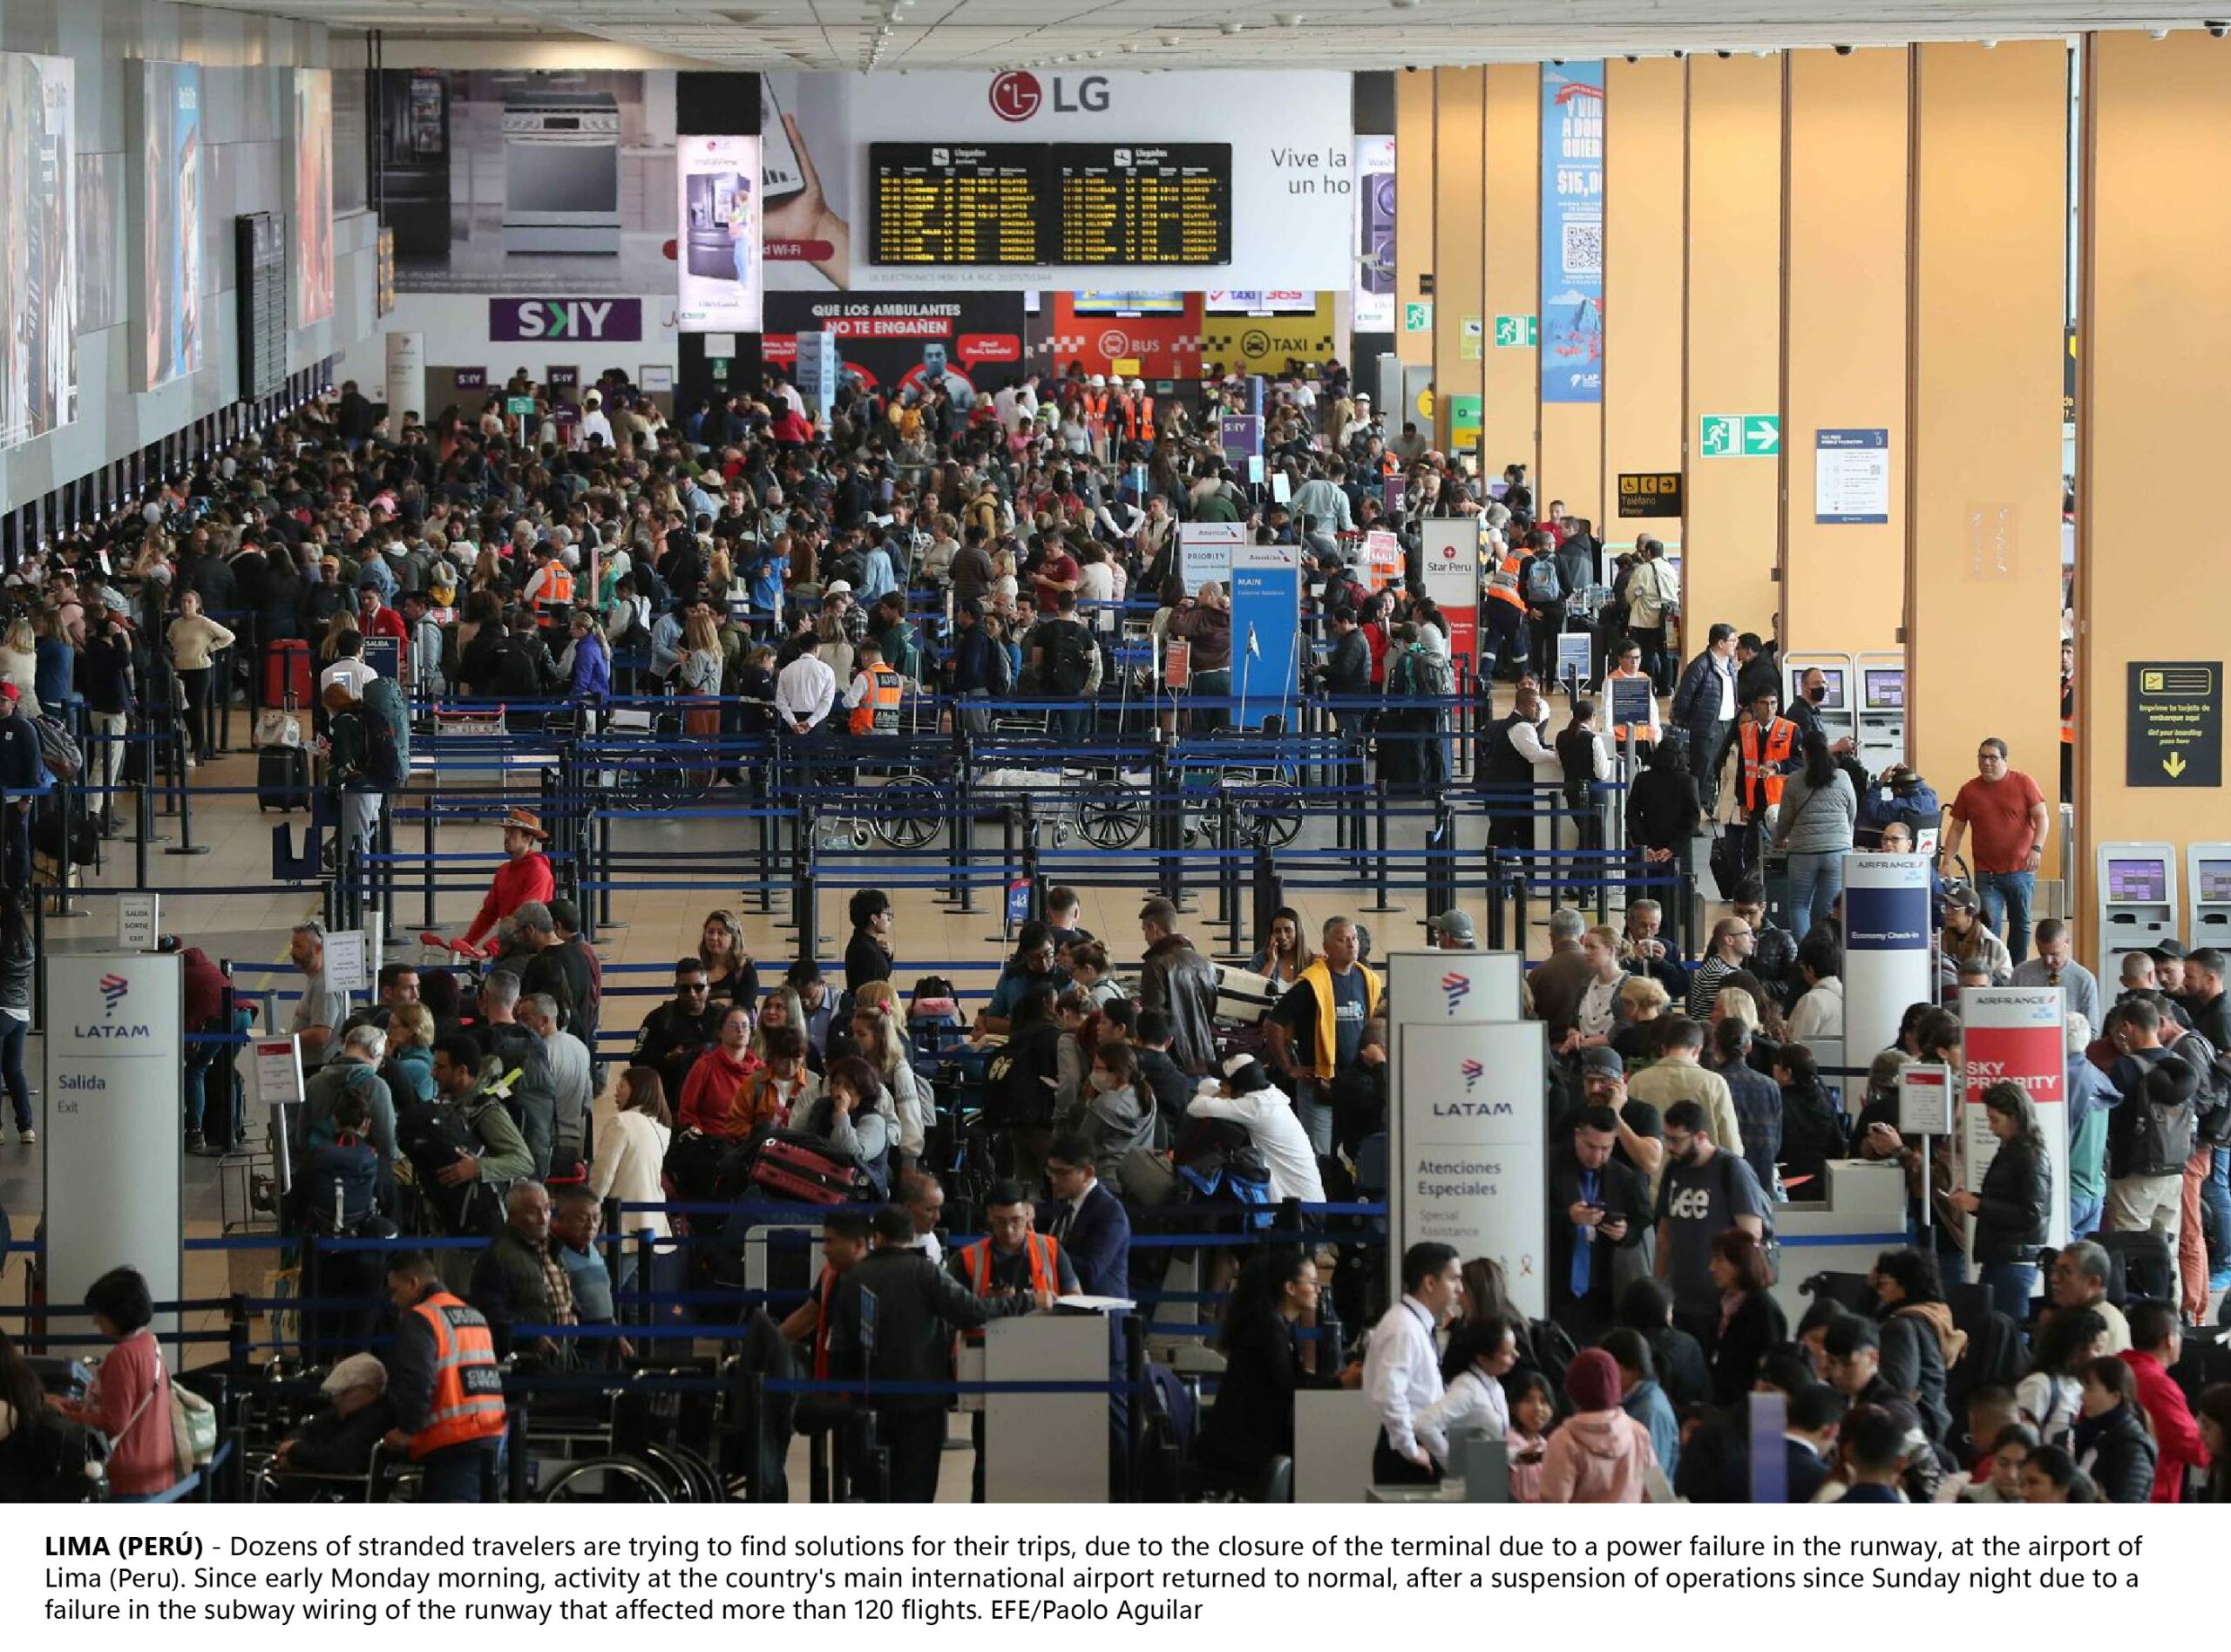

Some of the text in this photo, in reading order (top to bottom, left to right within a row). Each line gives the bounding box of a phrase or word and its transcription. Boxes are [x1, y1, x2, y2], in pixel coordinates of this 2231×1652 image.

[1054, 76, 1109, 112] LG
[1271, 147, 1347, 167] Vive la
[1289, 174, 1351, 194] un ho
[772, 244, 802, 255] Wi-Fi
[811, 304, 961, 316] QUE LOS AMBULANTES
[519, 301, 613, 337] SKY
[826, 317, 948, 334] NO TE ENGAÑEN
[1132, 339, 1160, 351] BUS
[1273, 338, 1308, 352] TAXI
[1427, 561, 1447, 572] Star
[1851, 931, 1887, 941] Economy
[1977, 996, 2045, 1005] AIRFRANCE
[75, 1026, 150, 1039] LATAM
[1966, 1062, 2004, 1075] SKY
[58, 1074, 105, 1090] Salida
[58, 1100, 78, 1114] Exit
[1434, 1103, 1514, 1115] LATAM
[1418, 1160, 1502, 1175] Atenciones
[1418, 1181, 1497, 1199] Especiales
[1669, 1179, 1710, 1219] Lee
[1421, 1209, 1460, 1222] Special
[1421, 1226, 1480, 1236] Assistance
